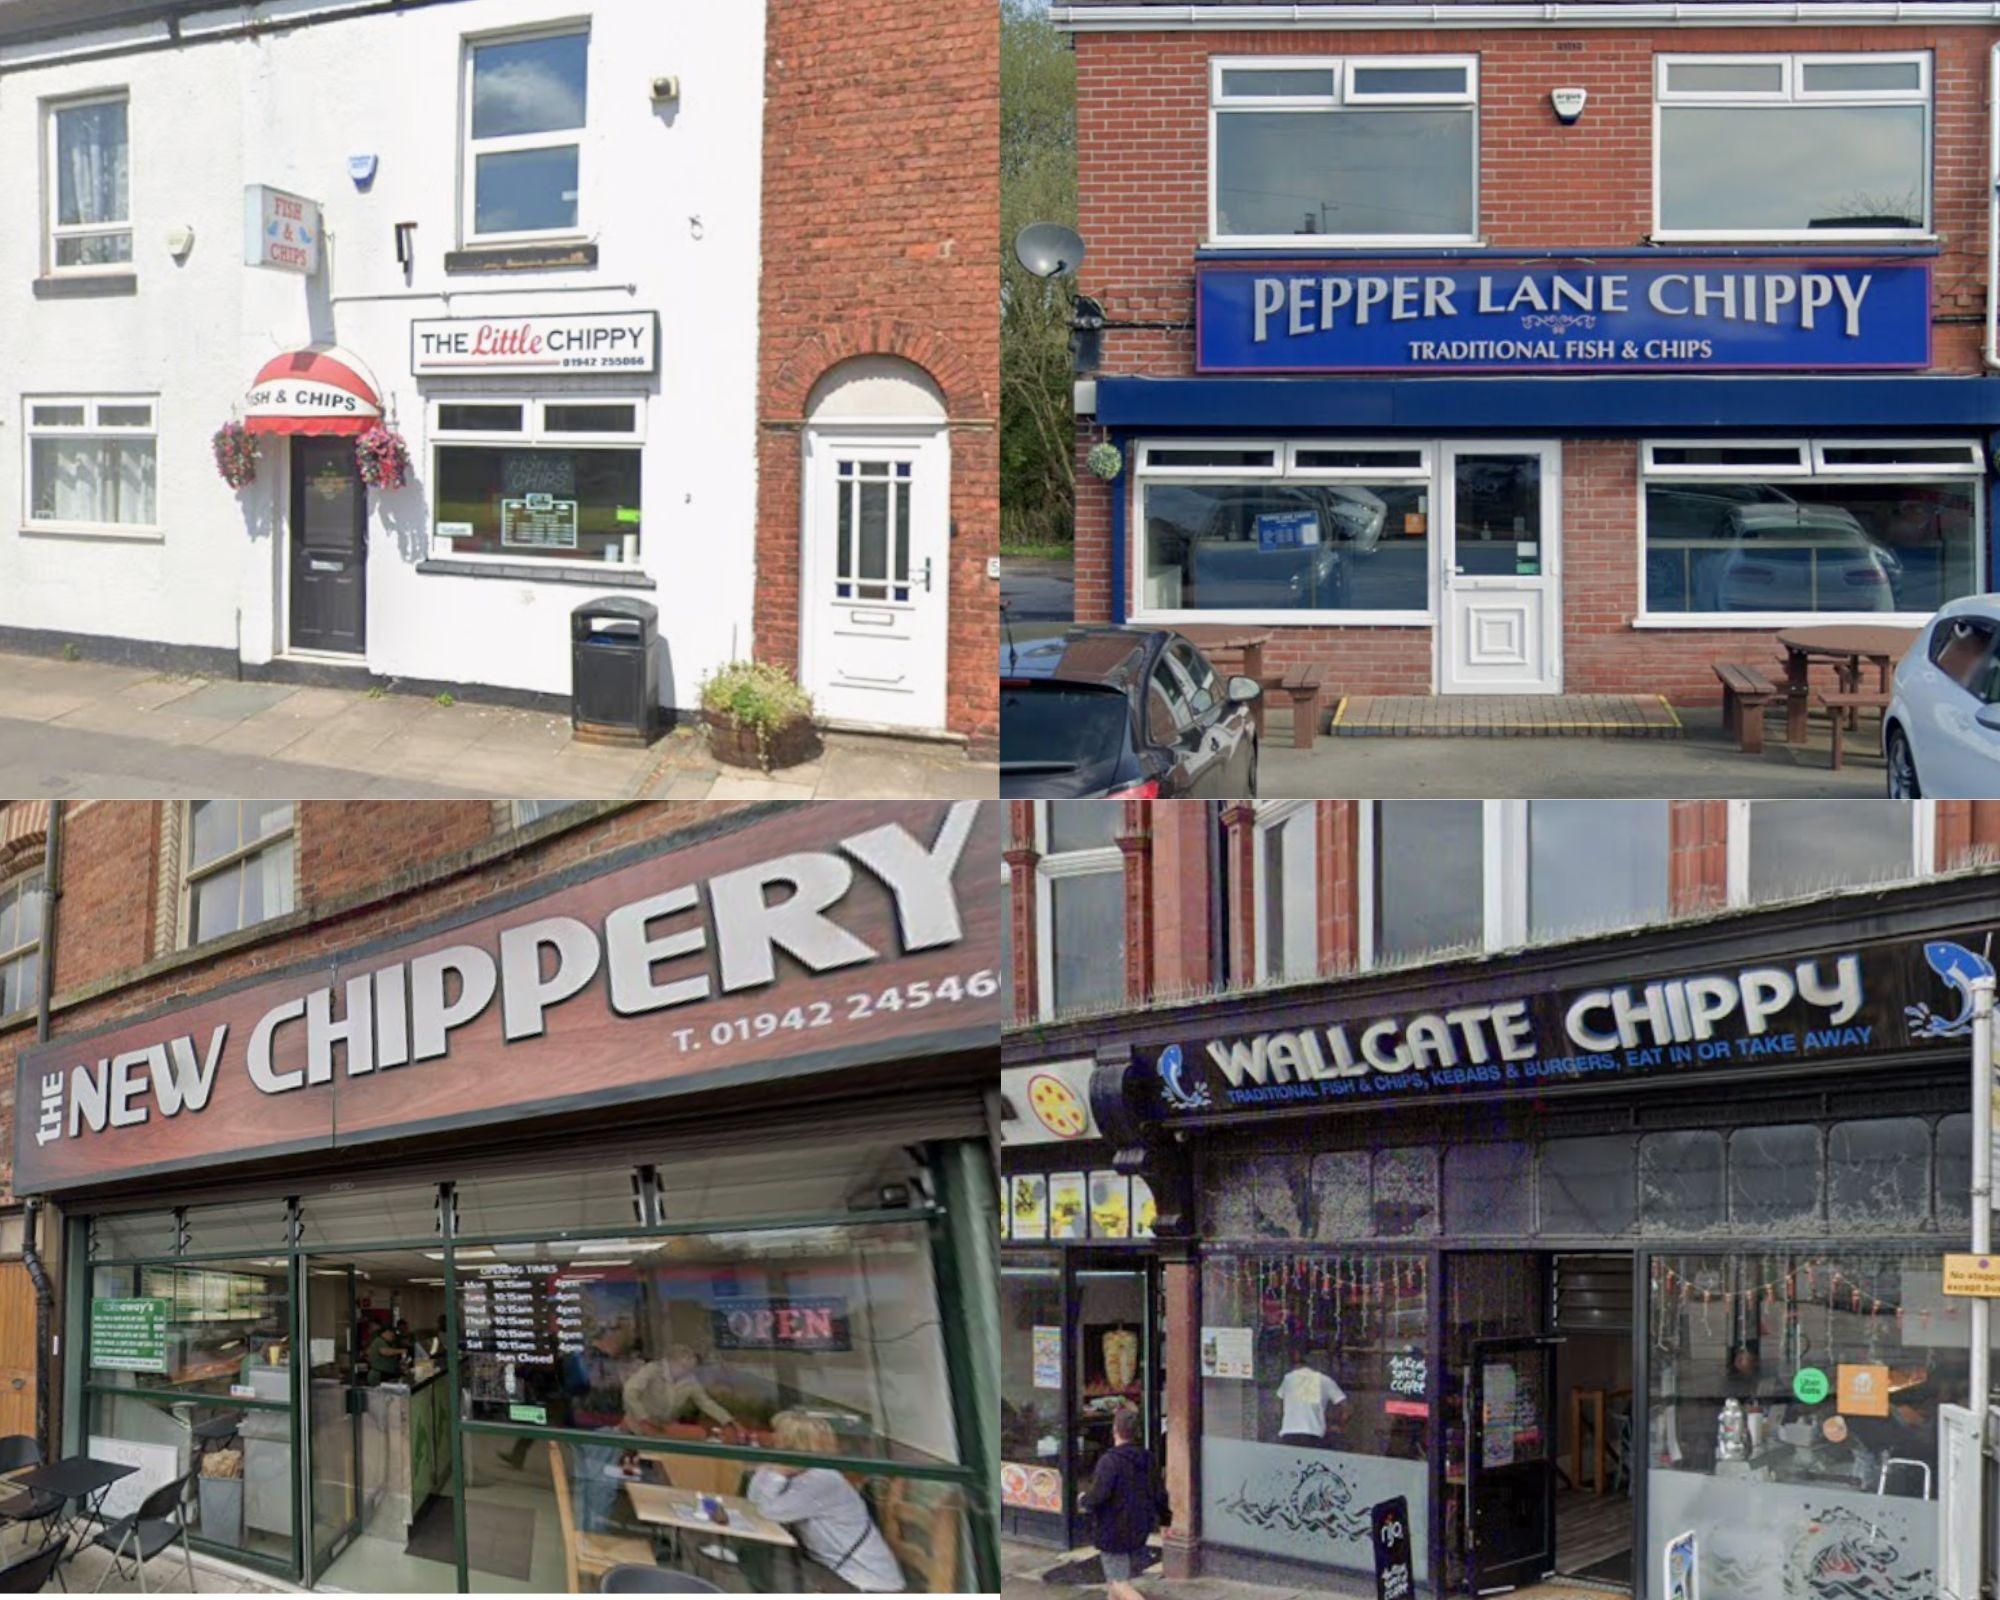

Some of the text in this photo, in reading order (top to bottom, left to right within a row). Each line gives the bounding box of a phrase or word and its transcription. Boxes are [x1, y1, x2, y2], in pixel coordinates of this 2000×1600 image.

[274, 197, 302, 220] FISH
[284, 223, 293, 242] &
[270, 243, 307, 266] CHIPS
[1254, 274, 1872, 342] PEPPER LANE CHIPPY
[420, 323, 645, 356] THE Little CHIPPY
[1408, 340, 1712, 361] TRADITIONAL FISH & CHIPS
[275, 389, 287, 403] &
[295, 390, 356, 412] CHIPS
[68, 1024, 228, 1138] NEW
[246, 800, 981, 1095] CHIPPERY
[671, 969, 1000, 1052] T. 01942 24546
[1206, 954, 1863, 1087] WALLGATE CHIPPY
[1228, 1027, 1873, 1104] TRADITIONAL FISH & CHIPS, KEBABS & BURGERS, EAT IN OR TAKE AWAY
[527, 1264, 559, 1274] TIMES
[463, 1280, 487, 1289] Mon
[555, 1279, 580, 1290] 4pm
[464, 1292, 487, 1301] Tues
[555, 1292, 580, 1302] 4pm
[464, 1304, 486, 1313] Wed
[556, 1304, 581, 1315] 4pm
[464, 1316, 491, 1325] Thurs
[556, 1316, 581, 1327] 4pm
[727, 1309, 832, 1340] OPEN
[466, 1329, 479, 1338] Fri
[558, 1330, 583, 1340] 4pm
[467, 1340, 482, 1349] Sat
[558, 1341, 584, 1352] 4pm
[496, 1352, 554, 1364] Sun Closed
